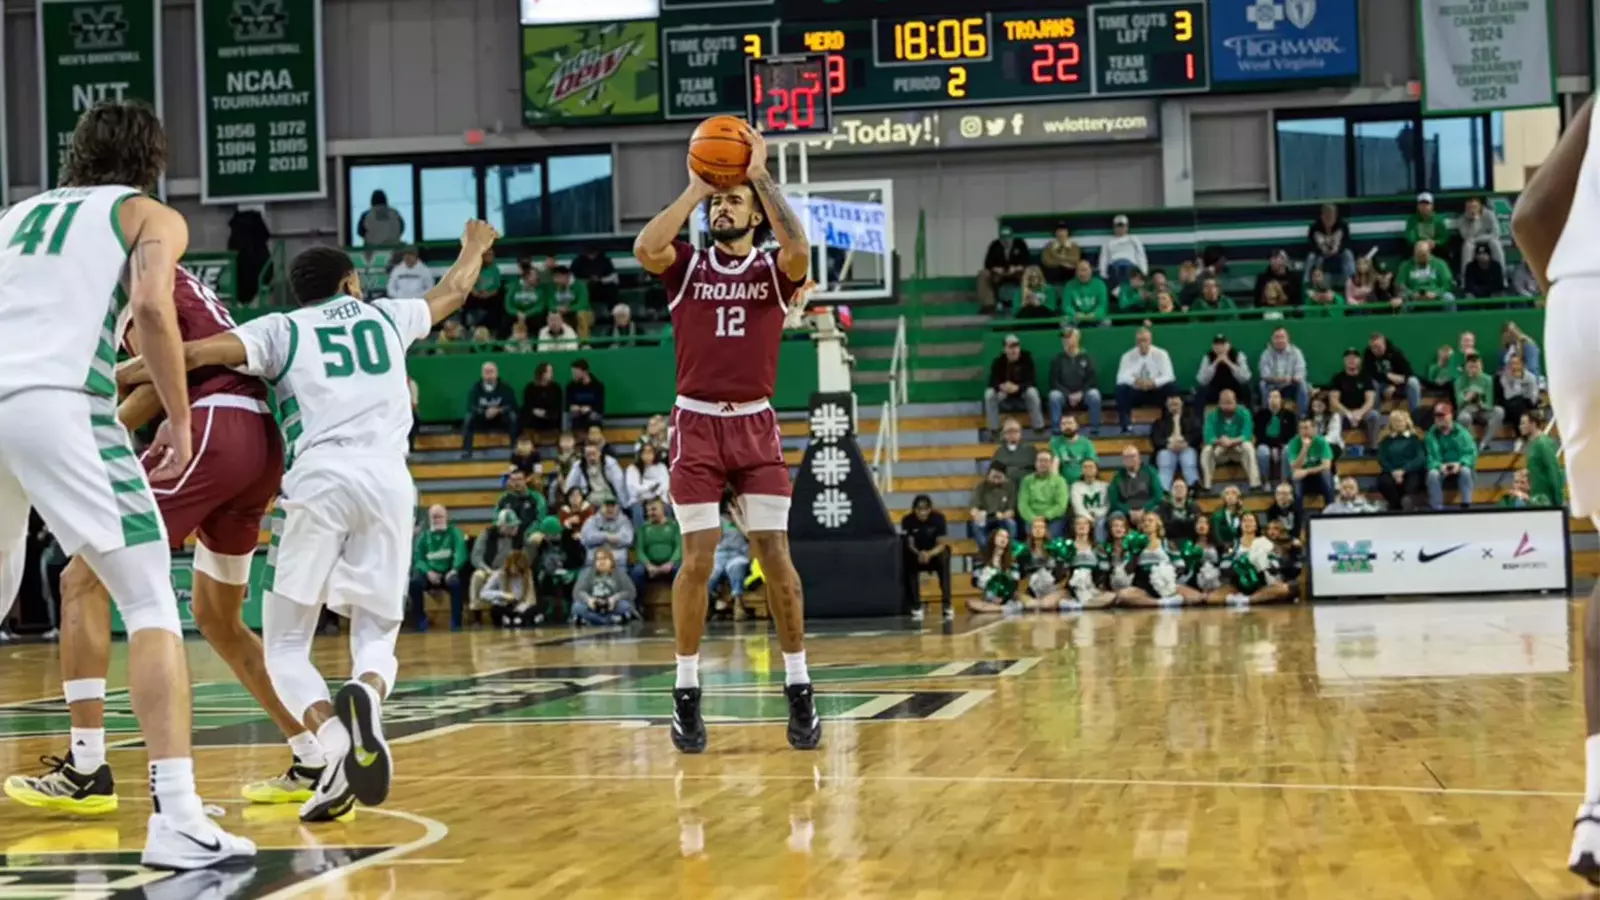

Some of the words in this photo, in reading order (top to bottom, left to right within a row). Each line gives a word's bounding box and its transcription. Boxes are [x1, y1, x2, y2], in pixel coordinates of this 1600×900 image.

[1004, 17, 1075, 41] TROJANS
[1099, 13, 1129, 29] TIME
[1132, 12, 1167, 28] OUTS
[1174, 10, 1193, 42] 3
[894, 17, 986, 61] 18:06
[1117, 28, 1149, 44] LEFT
[1469, 27, 1503, 42] 2024
[670, 38, 699, 54] TIME
[702, 36, 737, 51] OUTS
[687, 52, 719, 67] LEFT
[1031, 42, 1080, 83] 22
[1108, 55, 1145, 69] TEAM
[1185, 53, 1195, 80] 1
[226, 68, 294, 93] NCAA
[680, 77, 715, 91] TEAM
[893, 77, 942, 92] PERIOD
[947, 66, 966, 97] 2
[1105, 69, 1148, 85] FOULS
[212, 91, 309, 109] TOURNAMENT
[676, 91, 718, 107] FOULS
[1472, 86, 1507, 102] 2024
[767, 88, 814, 129] 20
[1043, 115, 1148, 134] wvlottery.com
[6, 200, 84, 256] 41
[693, 282, 769, 300] TROJANS
[323, 301, 361, 320] SPEER
[715, 306, 746, 337] 12
[314, 319, 391, 378] 50
